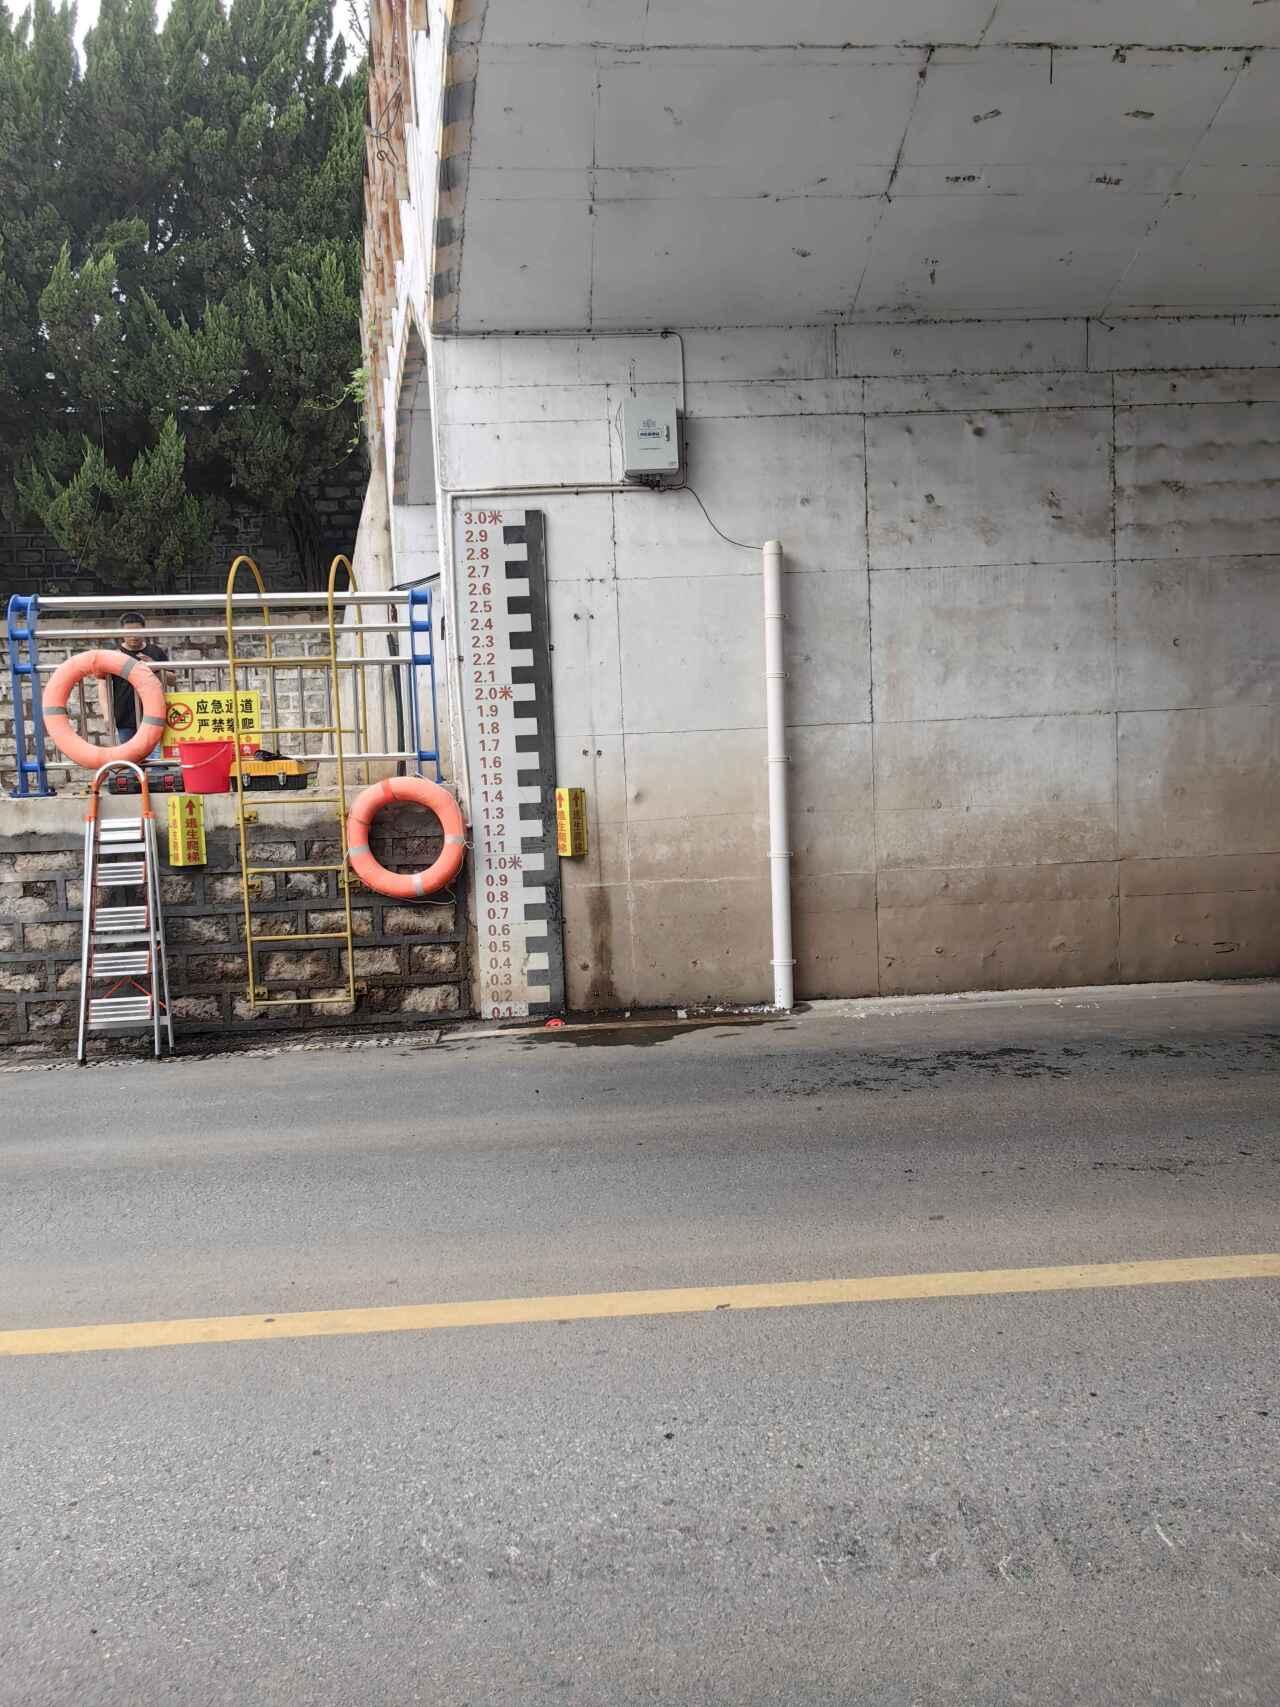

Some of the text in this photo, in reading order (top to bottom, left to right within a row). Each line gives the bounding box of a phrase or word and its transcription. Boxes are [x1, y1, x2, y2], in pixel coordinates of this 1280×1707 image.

[465, 529, 488, 543] 2.9
[466, 547, 489, 560] 2.8
[467, 565, 489, 578] 2.7
[468, 583, 491, 596] 2.6
[469, 600, 492, 613] 2.5
[471, 618, 493, 631] 2.4
[472, 635, 494, 648] 2.3
[473, 652, 495, 665] 2.2
[473, 670, 495, 683] 2.1
[477, 705, 498, 717] 1.9
[478, 722, 500, 734] 1.8
[479, 739, 500, 751] 1.7
[479, 756, 502, 768] 1.6
[481, 773, 502, 785] 1.5
[482, 790, 504, 802] 1.4
[483, 807, 504, 819] 1.3
[484, 824, 505, 836] 1.2
[485, 841, 505, 853] 1.1
[486, 874, 508, 886] 0.9
[487, 891, 509, 903] 0.8
[488, 907, 509, 919] 0.7
[488, 924, 510, 936] 0.6
[489, 941, 510, 953] 0.5
[490, 957, 511, 970] 0.4
[491, 973, 512, 985] 0.3
[491, 990, 512, 1002] 0.2
[492, 1006, 512, 1017] 0.1
